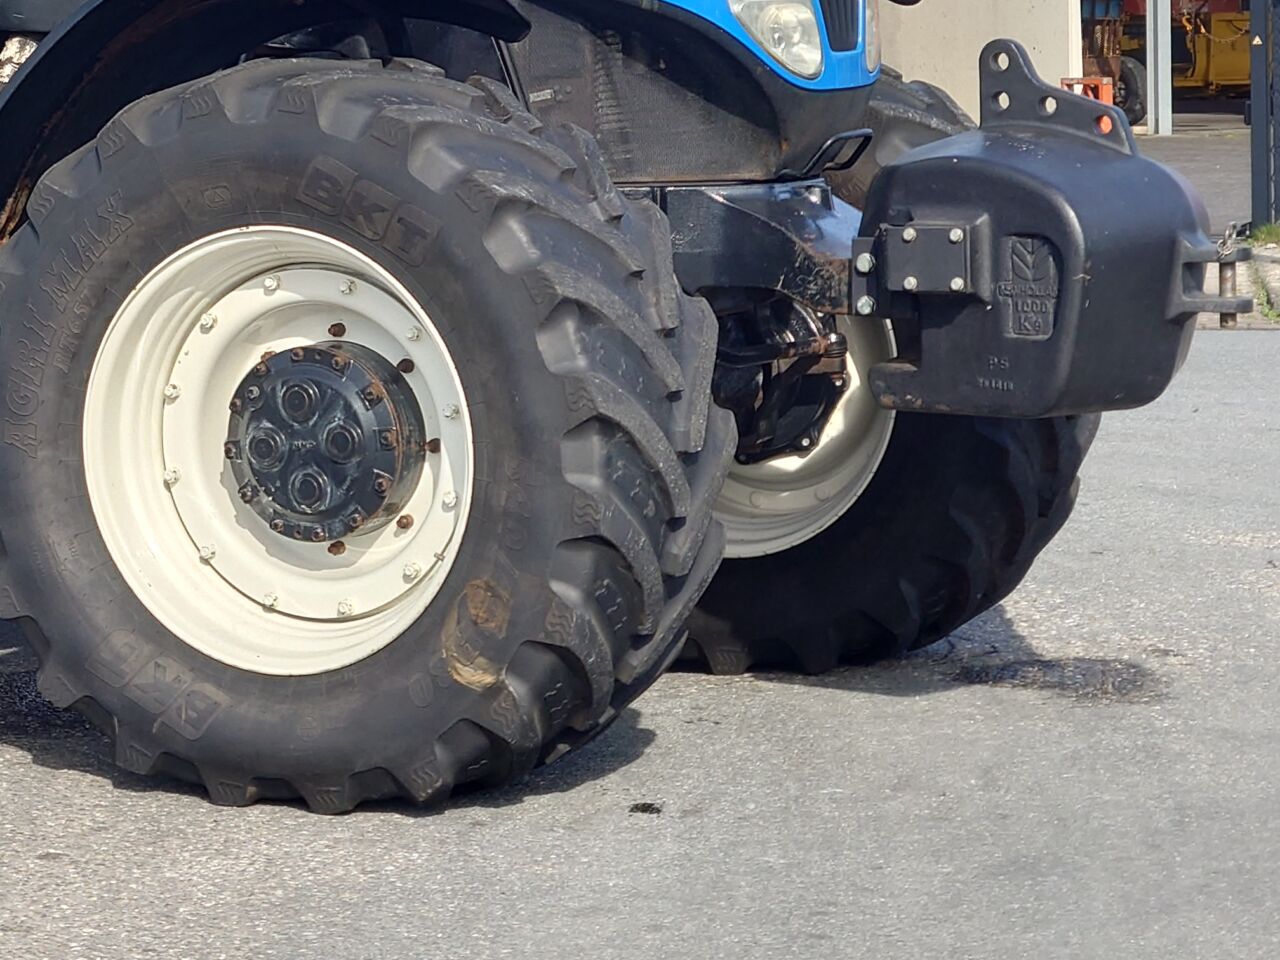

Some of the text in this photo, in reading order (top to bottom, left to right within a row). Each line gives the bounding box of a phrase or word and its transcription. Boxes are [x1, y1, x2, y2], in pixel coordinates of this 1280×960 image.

[38, 186, 136, 314] MAX
[297, 156, 441, 267] BKT
[1015, 300, 1049, 314] 1000
